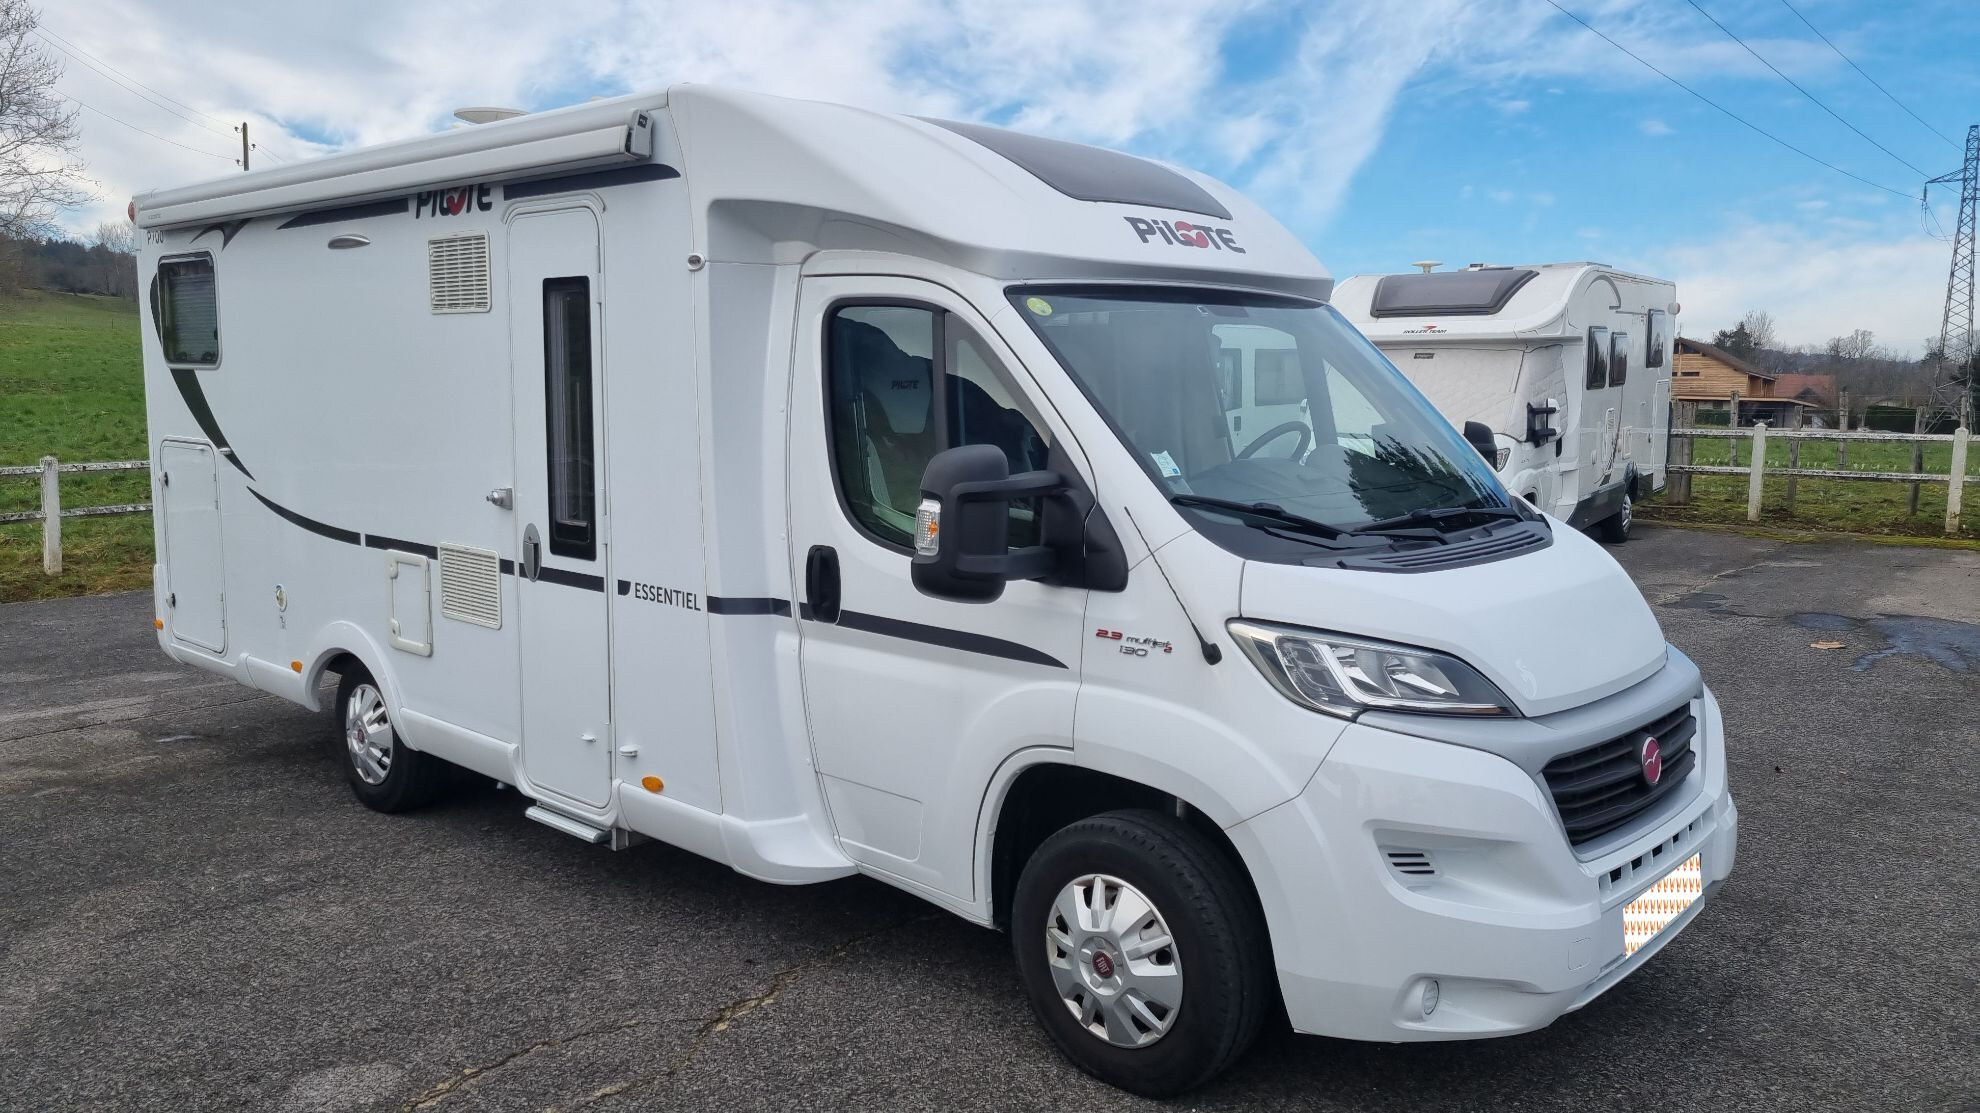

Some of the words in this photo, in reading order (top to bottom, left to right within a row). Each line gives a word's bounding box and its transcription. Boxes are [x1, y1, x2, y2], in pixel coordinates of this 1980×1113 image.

[634, 582, 702, 612] ESSENTIEL
[1119, 645, 1148, 657] 130
[1096, 957, 1110, 973] FIAT
